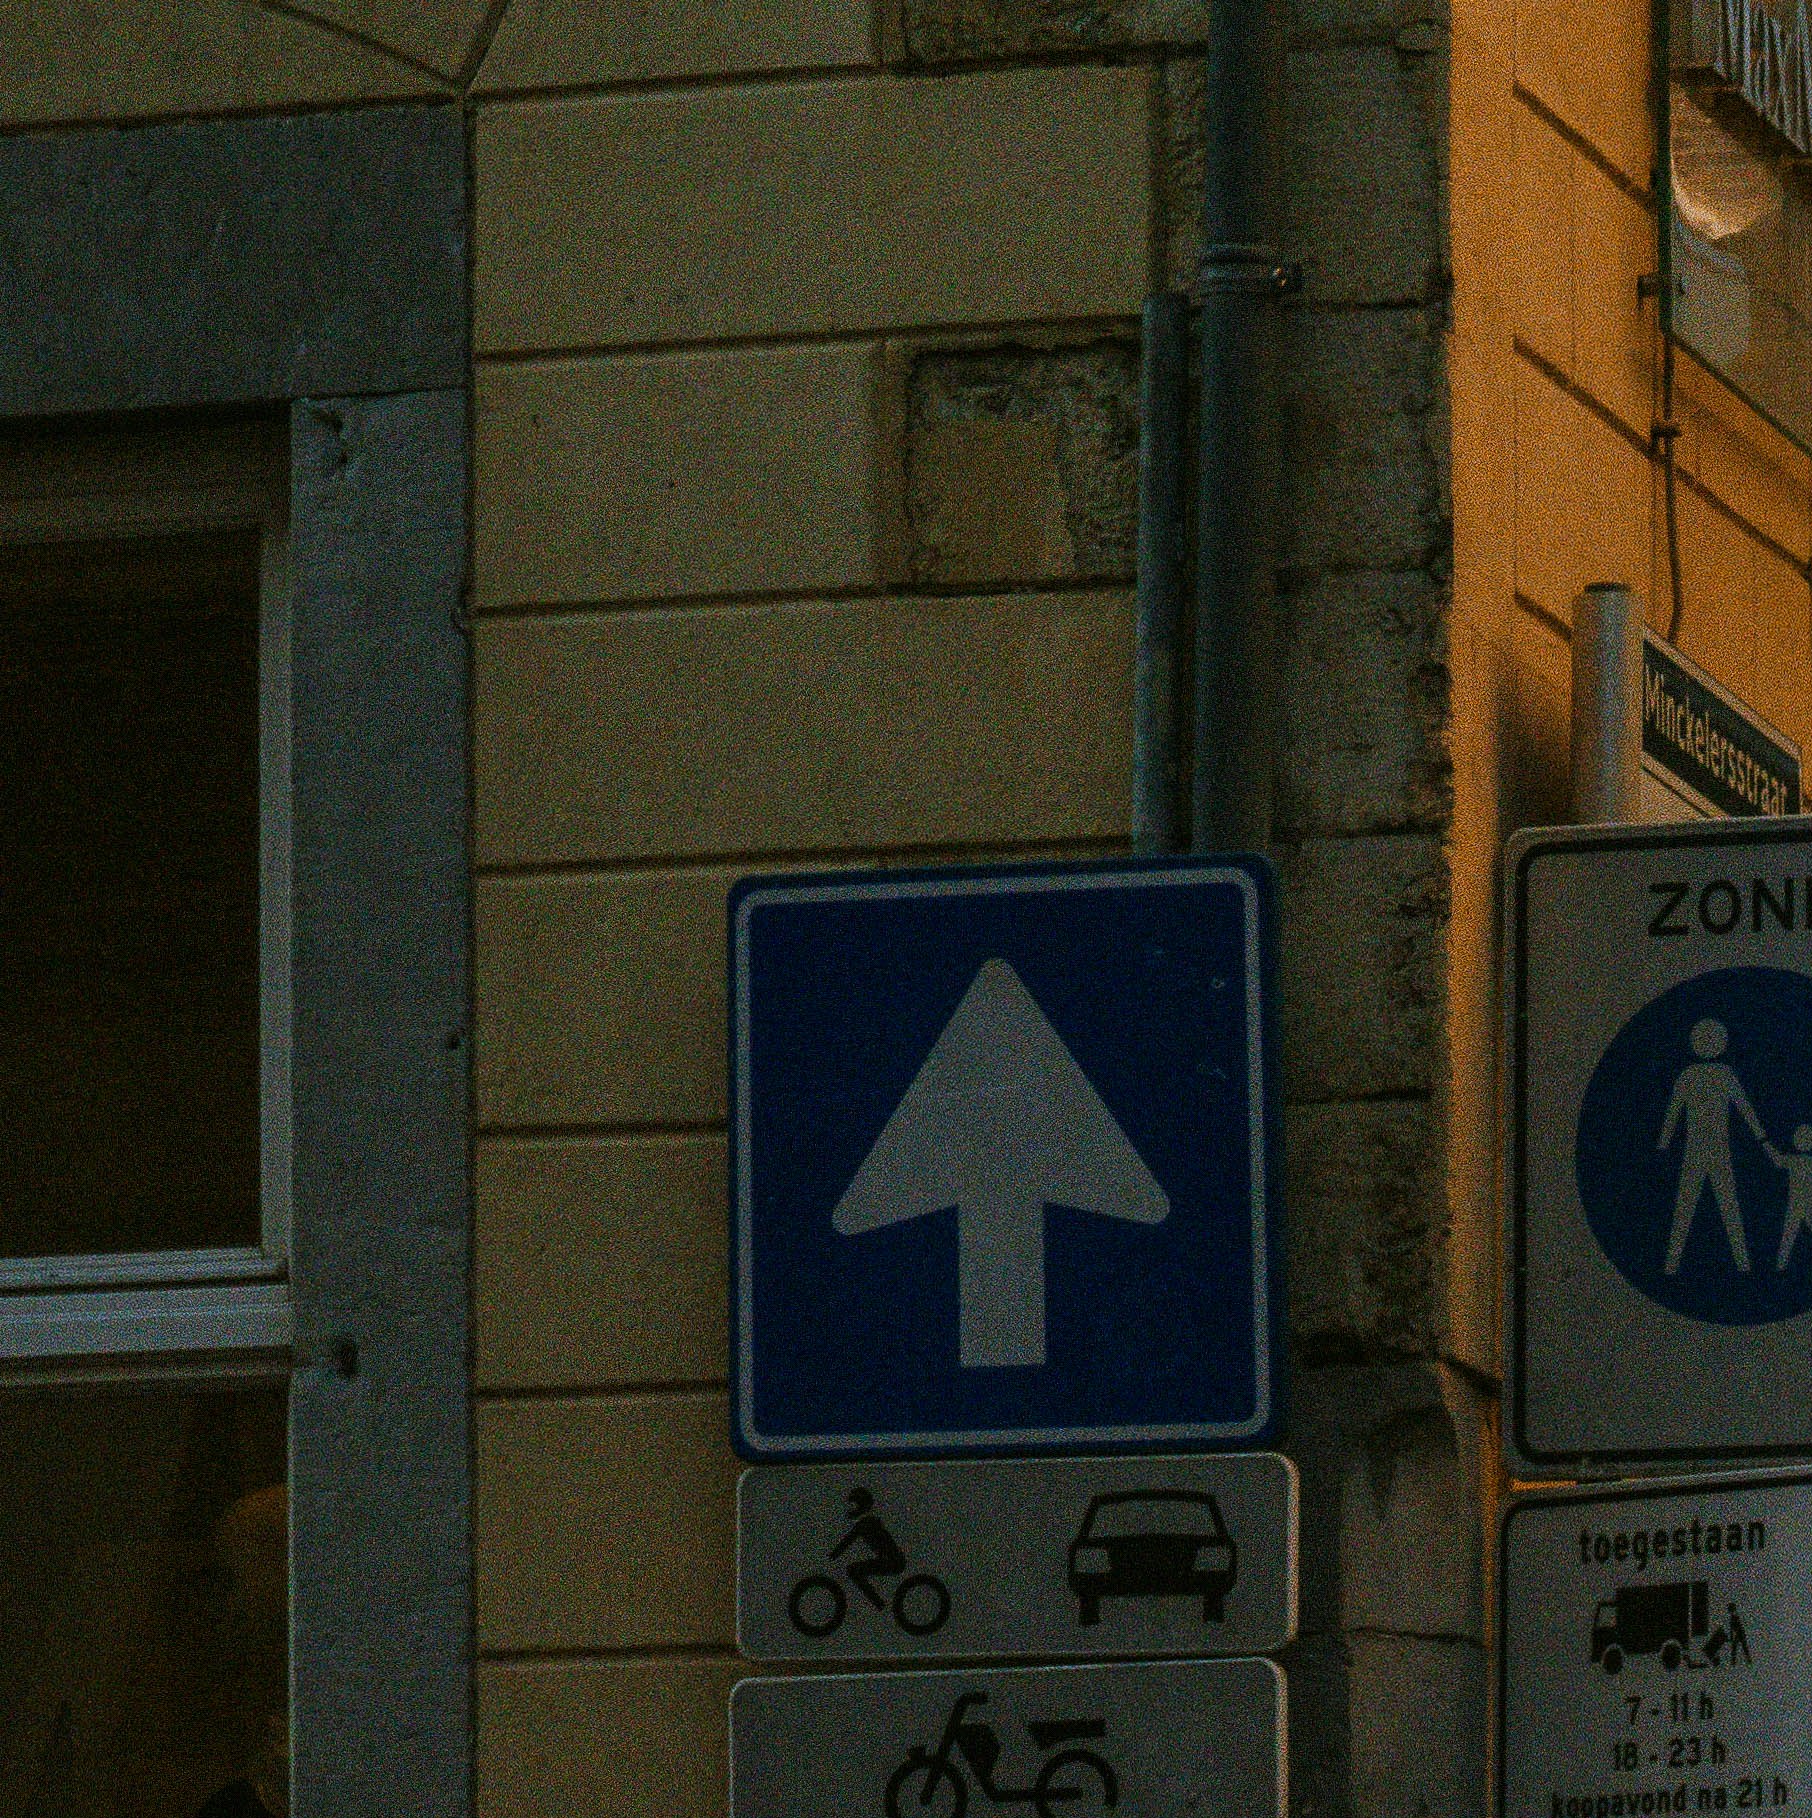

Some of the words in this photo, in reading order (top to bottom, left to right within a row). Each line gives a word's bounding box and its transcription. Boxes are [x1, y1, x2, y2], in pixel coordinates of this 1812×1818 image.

[1644, 662, 1788, 817] Minckelersstraat
[1579, 1518, 1766, 1571] toegestaan
[1624, 1695, 1641, 1725] 7
[1669, 1692, 1688, 1722] 11
[1700, 1691, 1714, 1720] h
[1613, 1741, 1638, 1771] 18
[1668, 1737, 1700, 1768] 23
[1711, 1735, 1726, 1764] h
[1699, 1785, 1727, 1811] na
[1737, 1778, 1763, 1807] 21
[1774, 1777, 1788, 1805] h
